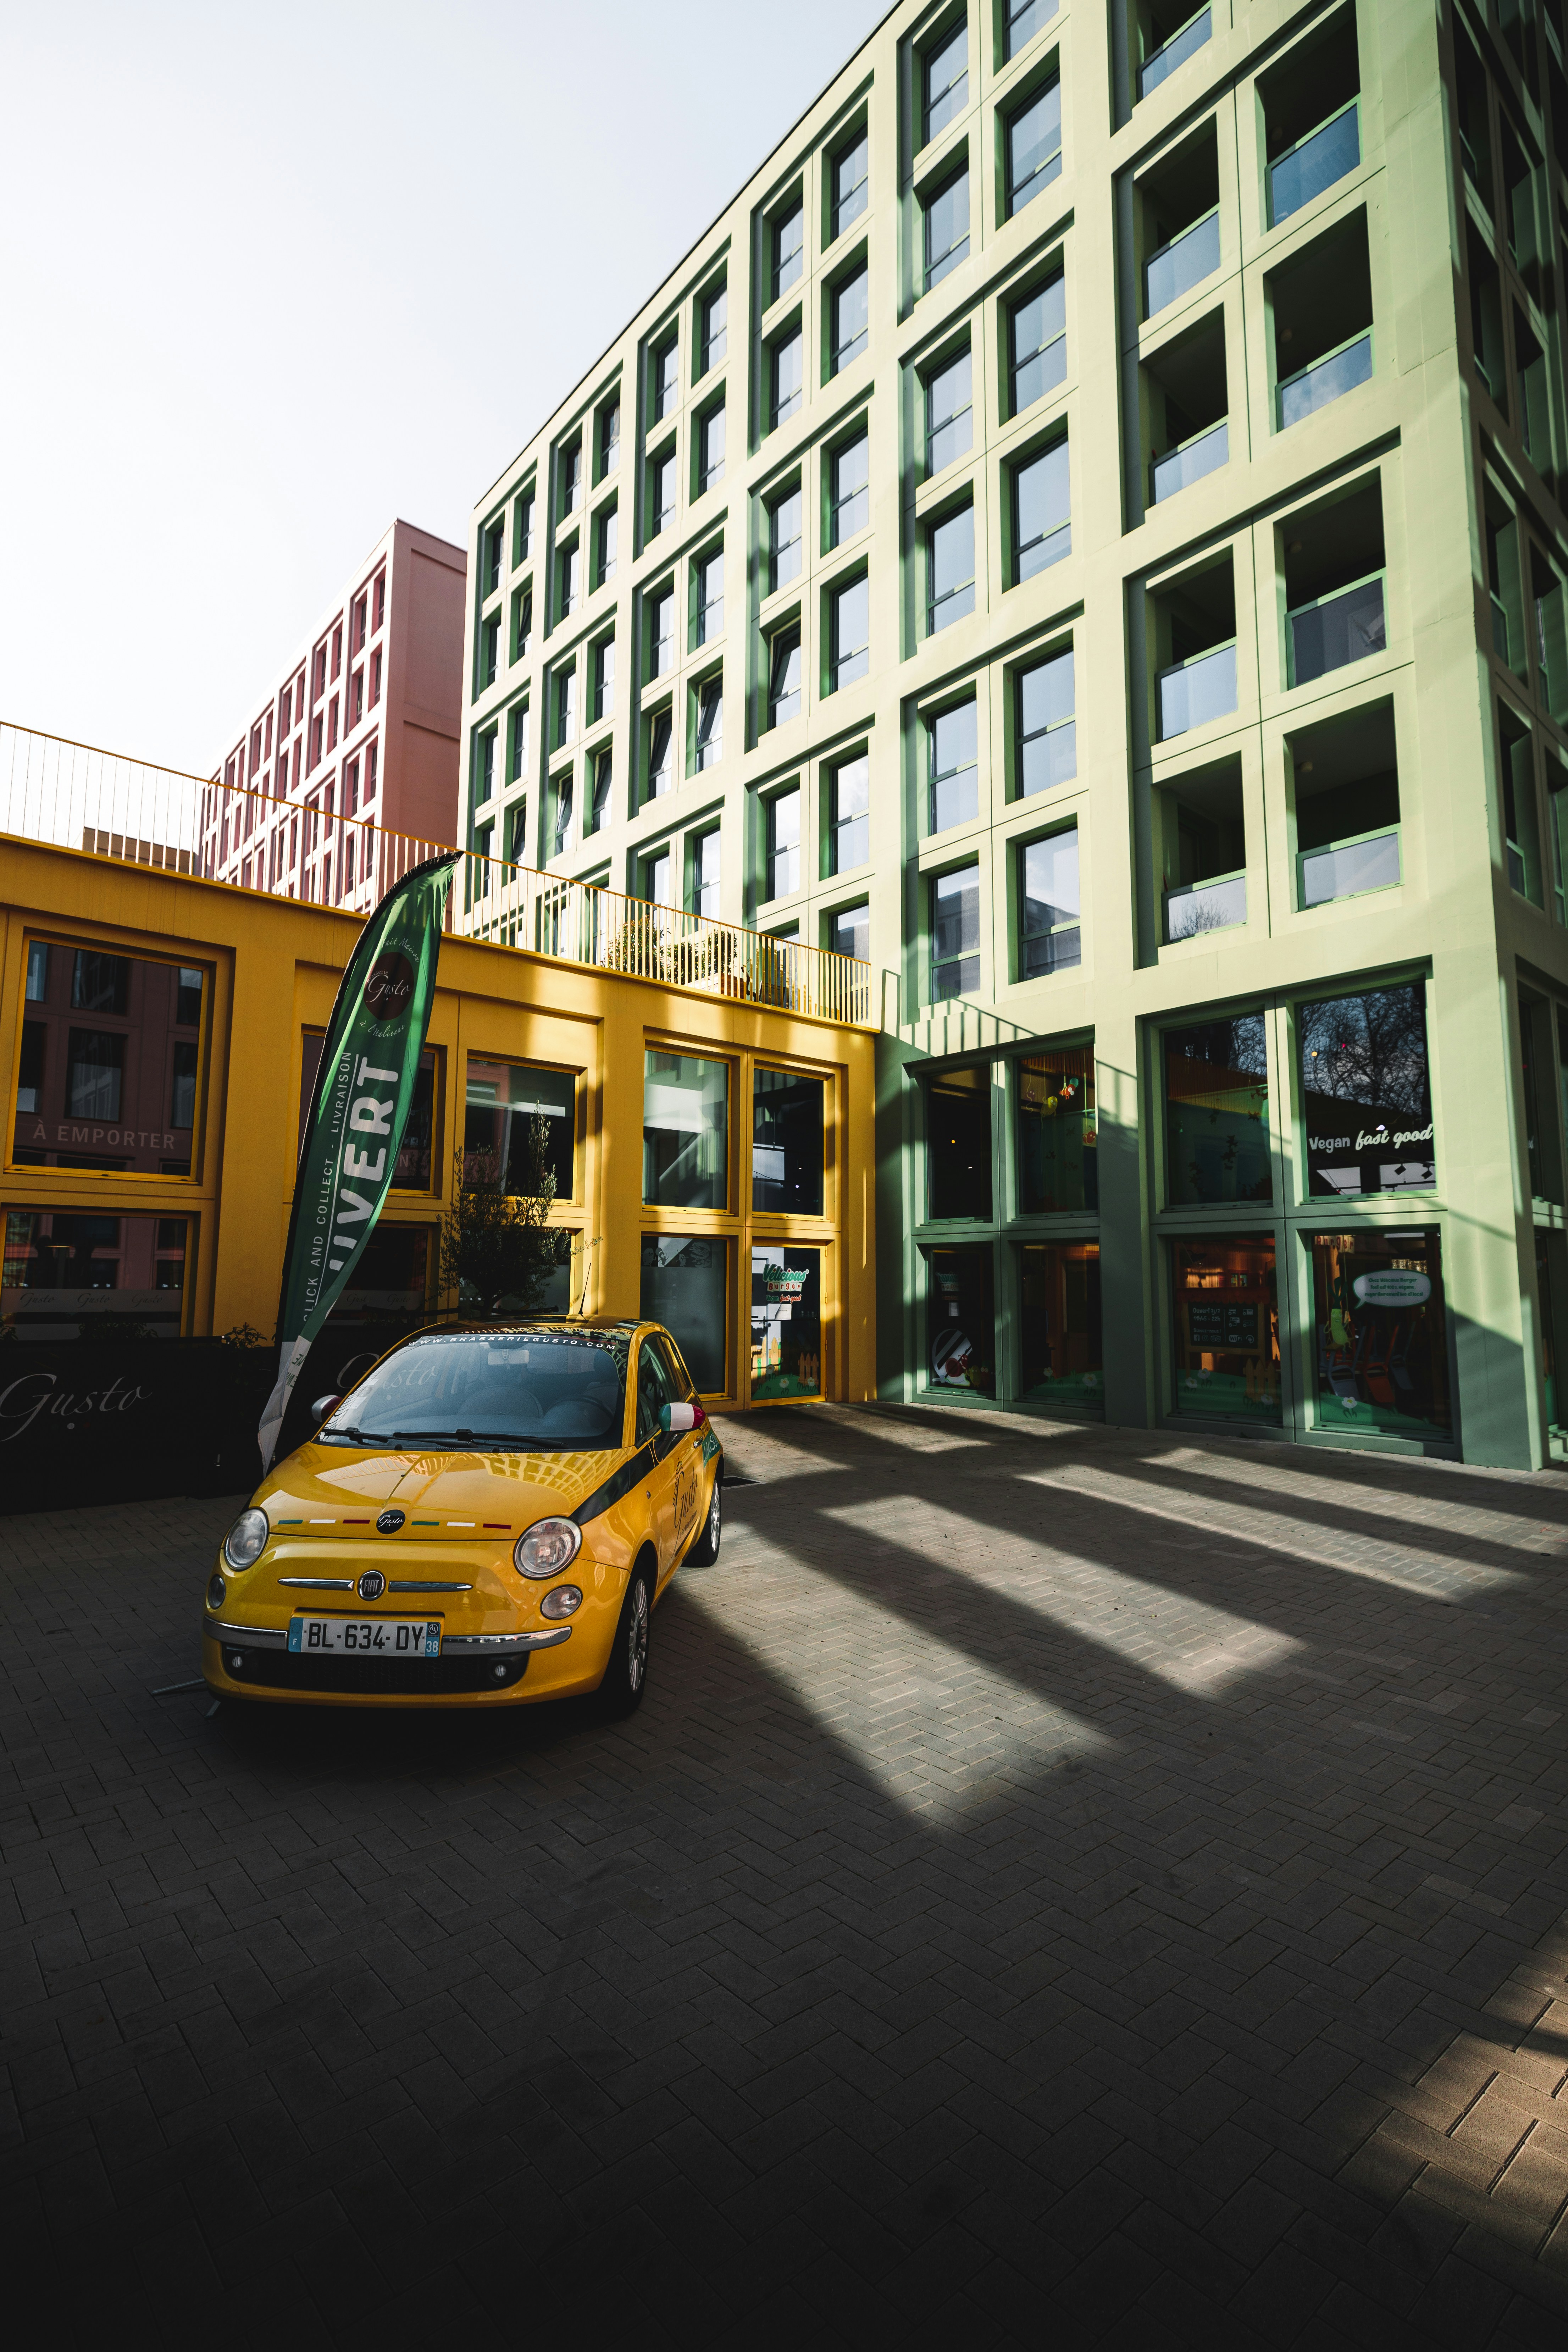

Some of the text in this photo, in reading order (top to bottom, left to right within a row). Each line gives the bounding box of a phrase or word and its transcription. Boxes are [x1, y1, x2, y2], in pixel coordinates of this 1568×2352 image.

[399, 938, 419, 962] Maison
[366, 974, 411, 1002] Gusto
[367, 969, 388, 983] Brasserie
[331, 1052, 351, 1133] LIVRAISON
[33, 1119, 175, 1150] À EMPORTER
[1309, 1124, 1433, 1153] Vegan fast good
[330, 1057, 398, 1271] VERT
[316, 1158, 333, 1224] COLLECT
[311, 1236, 323, 1267] AND
[20, 1293, 163, 1308] Gusto Gusto Gusto
[347, 1293, 367, 1306] Gust
[780, 1294, 790, 1303] fast
[790, 1294, 802, 1304] good
[0, 1373, 153, 1442] Gusto
[377, 1516, 404, 1527] Gusto
[671, 1465, 698, 1557] Gusto
[364, 1579, 379, 1592] FIAT
[426, 1641, 438, 1653] 38
